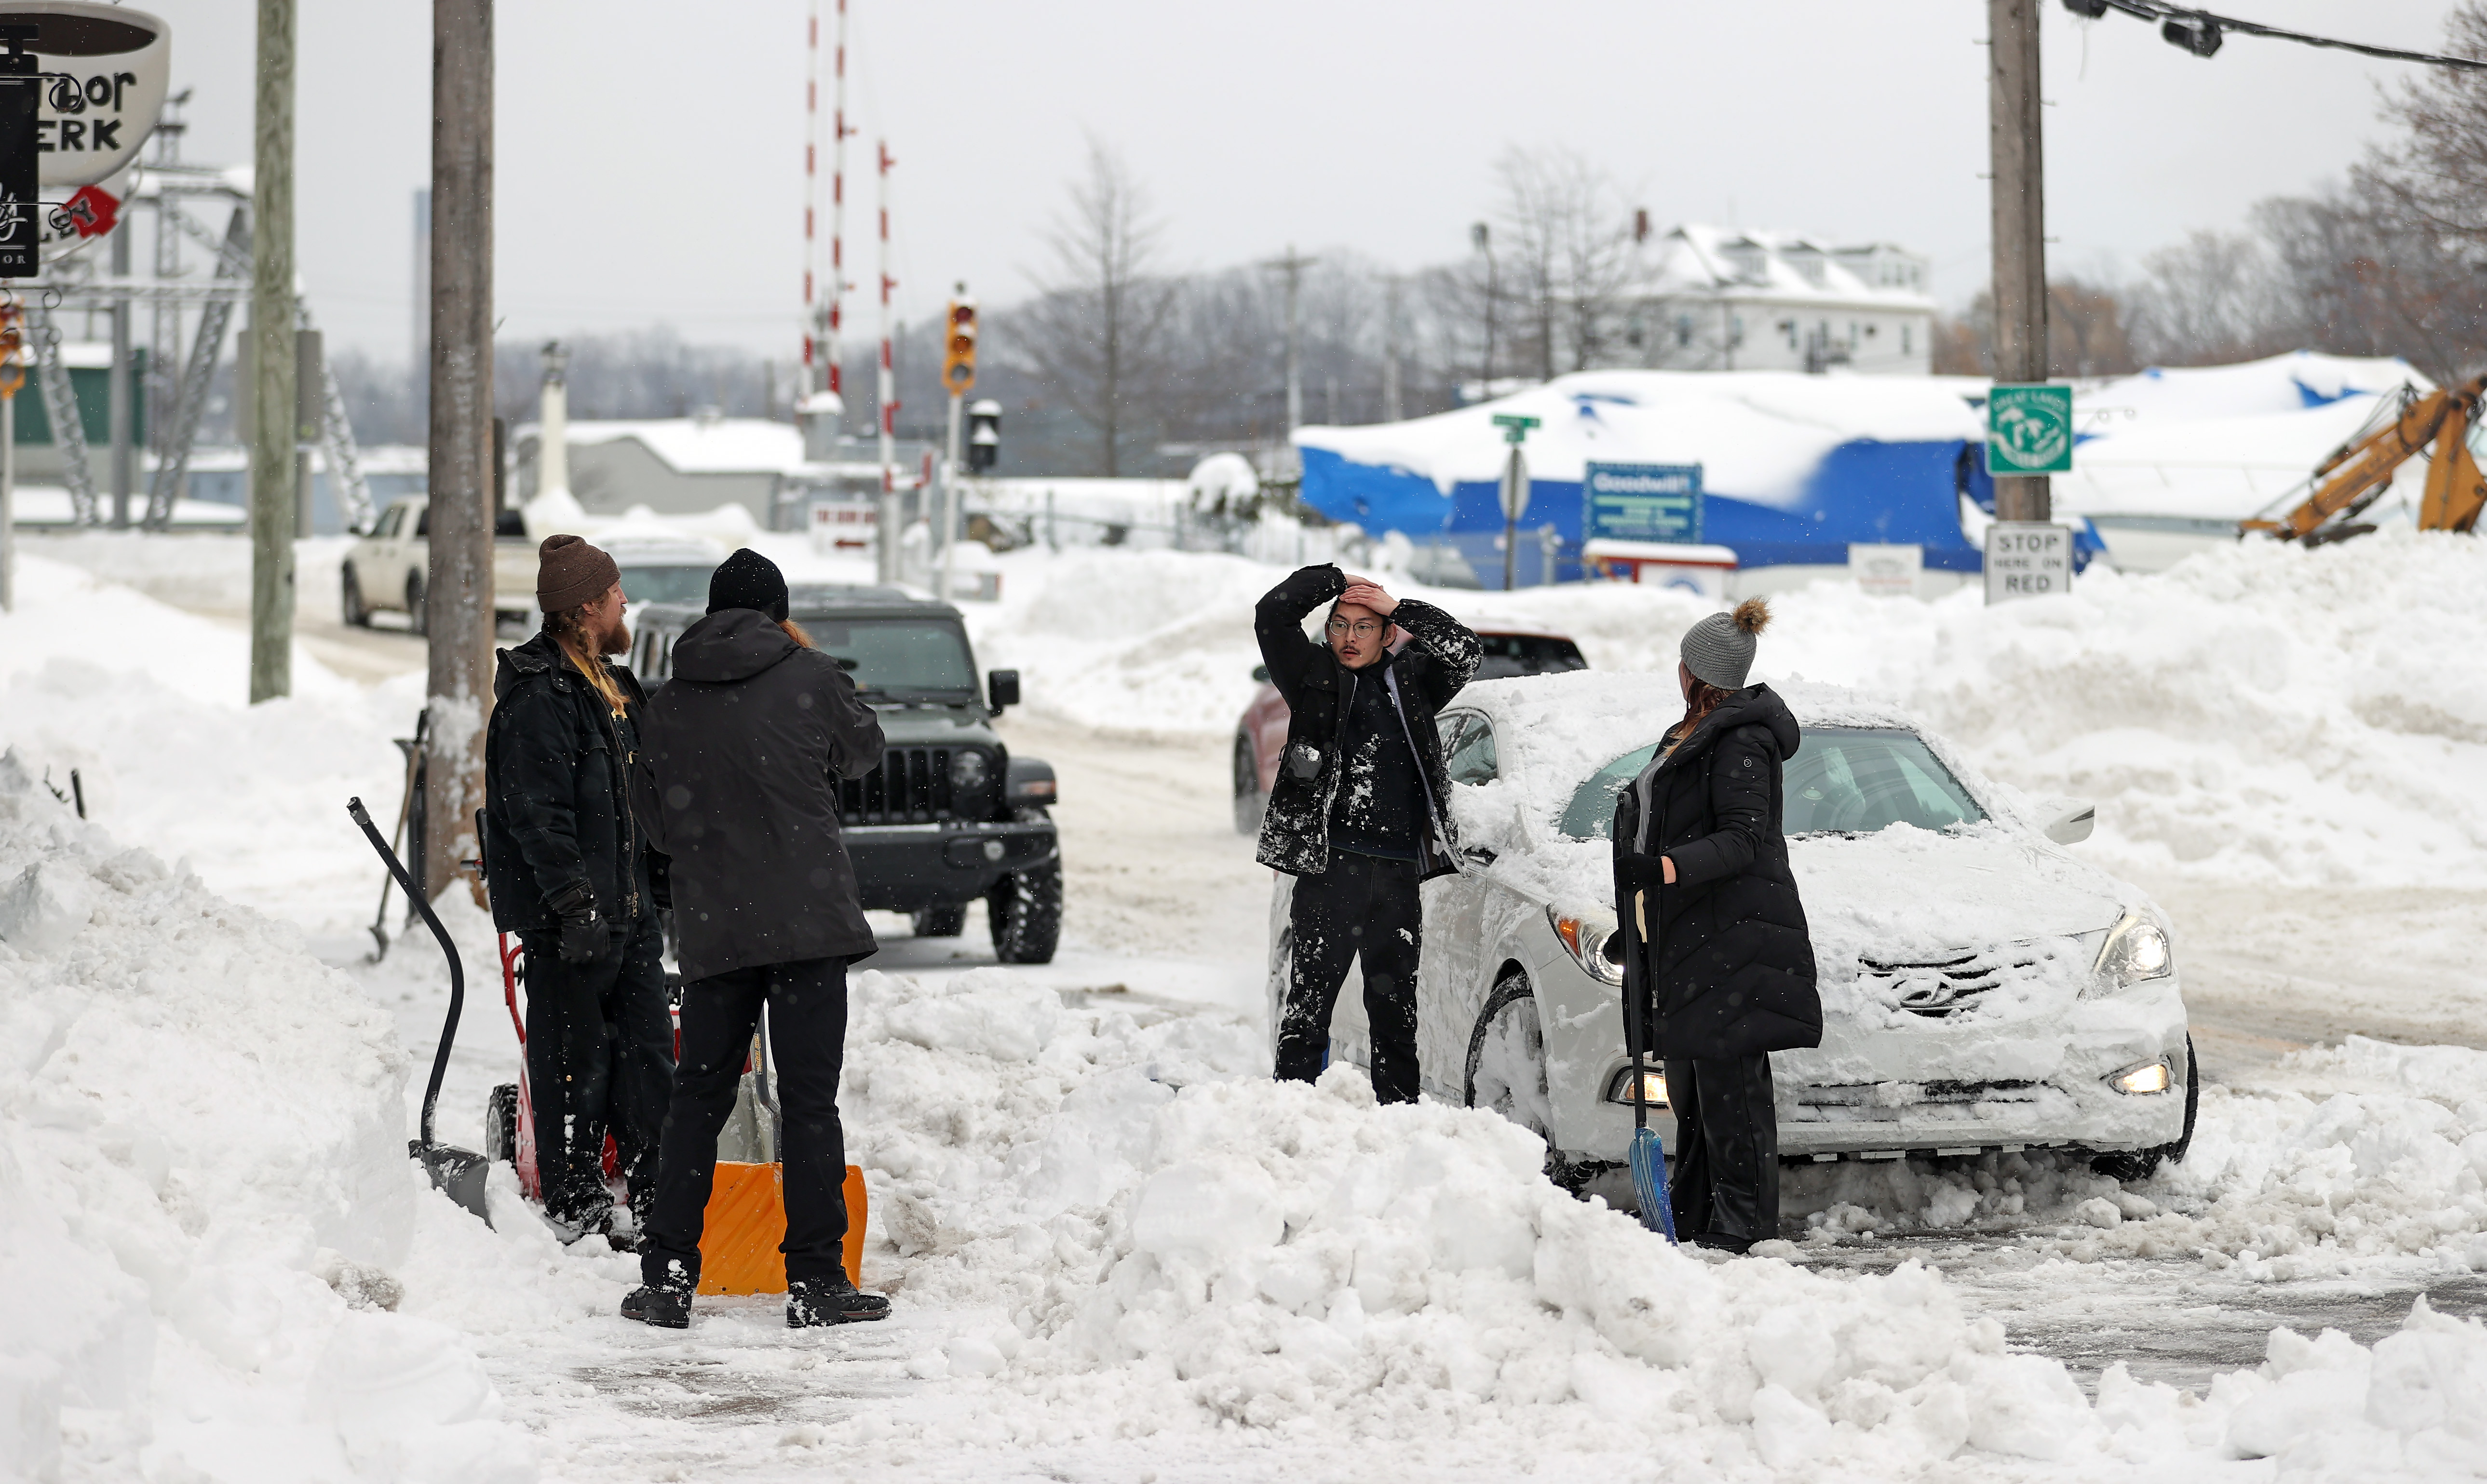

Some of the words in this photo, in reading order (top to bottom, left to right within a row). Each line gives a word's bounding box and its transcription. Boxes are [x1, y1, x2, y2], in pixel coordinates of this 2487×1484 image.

[1999, 534, 2059, 552] STOP
[1994, 558, 2030, 569] HERE
[2042, 558, 2062, 569] ON
[2006, 574, 2051, 593] RED
